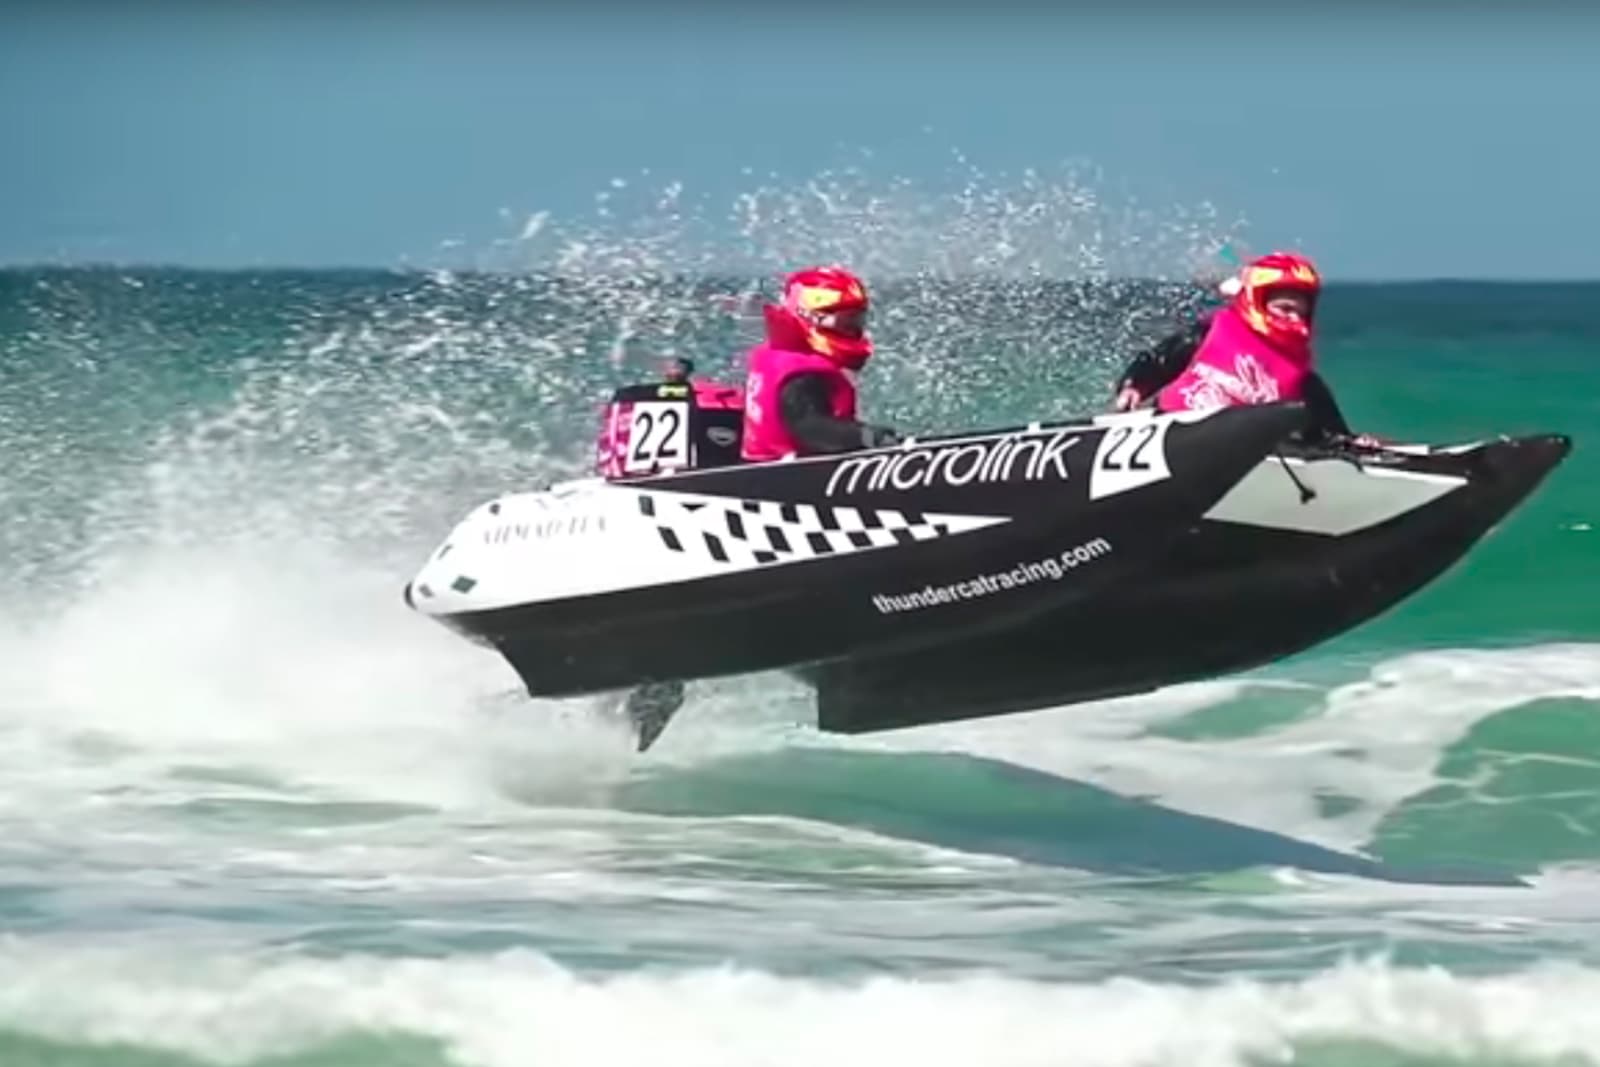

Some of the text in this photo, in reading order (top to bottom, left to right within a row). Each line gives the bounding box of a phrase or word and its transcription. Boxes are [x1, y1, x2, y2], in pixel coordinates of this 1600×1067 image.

[633, 408, 680, 461] 22
[825, 430, 1080, 496] microlink
[1101, 424, 1159, 471] 22
[872, 536, 1112, 614] thundercatracing.com
